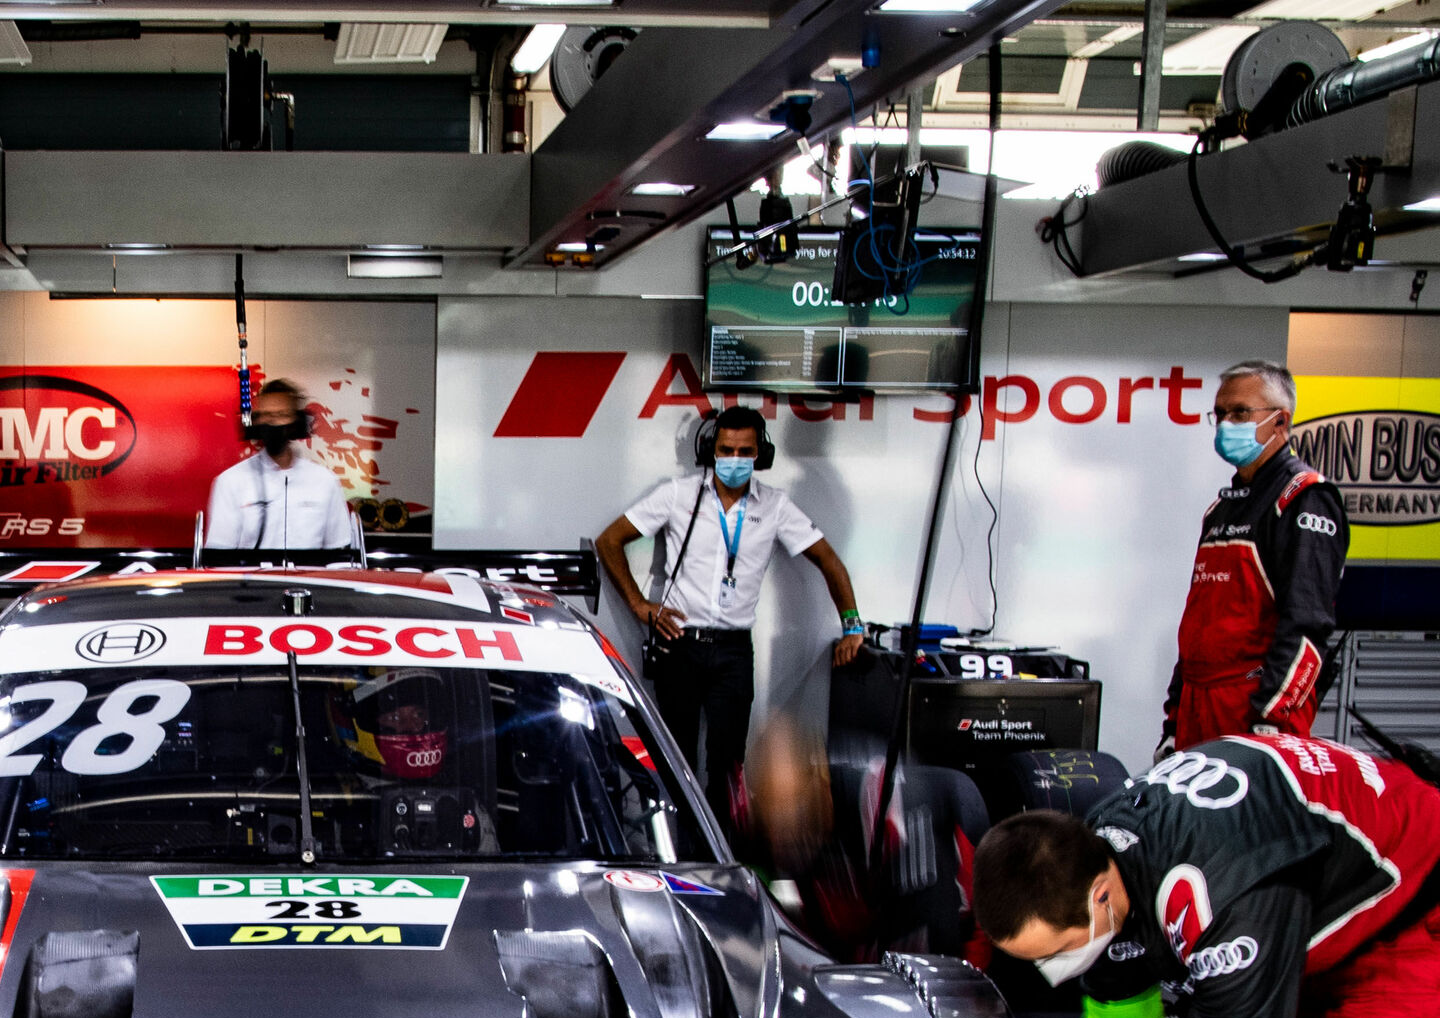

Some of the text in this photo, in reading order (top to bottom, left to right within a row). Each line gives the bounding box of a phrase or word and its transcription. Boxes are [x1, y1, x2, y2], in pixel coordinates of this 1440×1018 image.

[818, 246, 832, 256] for
[1289, 418, 1440, 483] WIN BUS
[34, 461, 103, 484] Filter
[1345, 494, 1440, 514] ERMANY
[58, 518, 86, 536] 5
[203, 624, 523, 662] BOSCH
[960, 654, 1013, 679] 99
[972, 719, 1033, 731] Audi Sport
[972, 730, 1046, 741] Team Phoenix
[198, 878, 433, 897] DEKRA
[264, 900, 362, 919] 28
[230, 925, 401, 943] DTM
